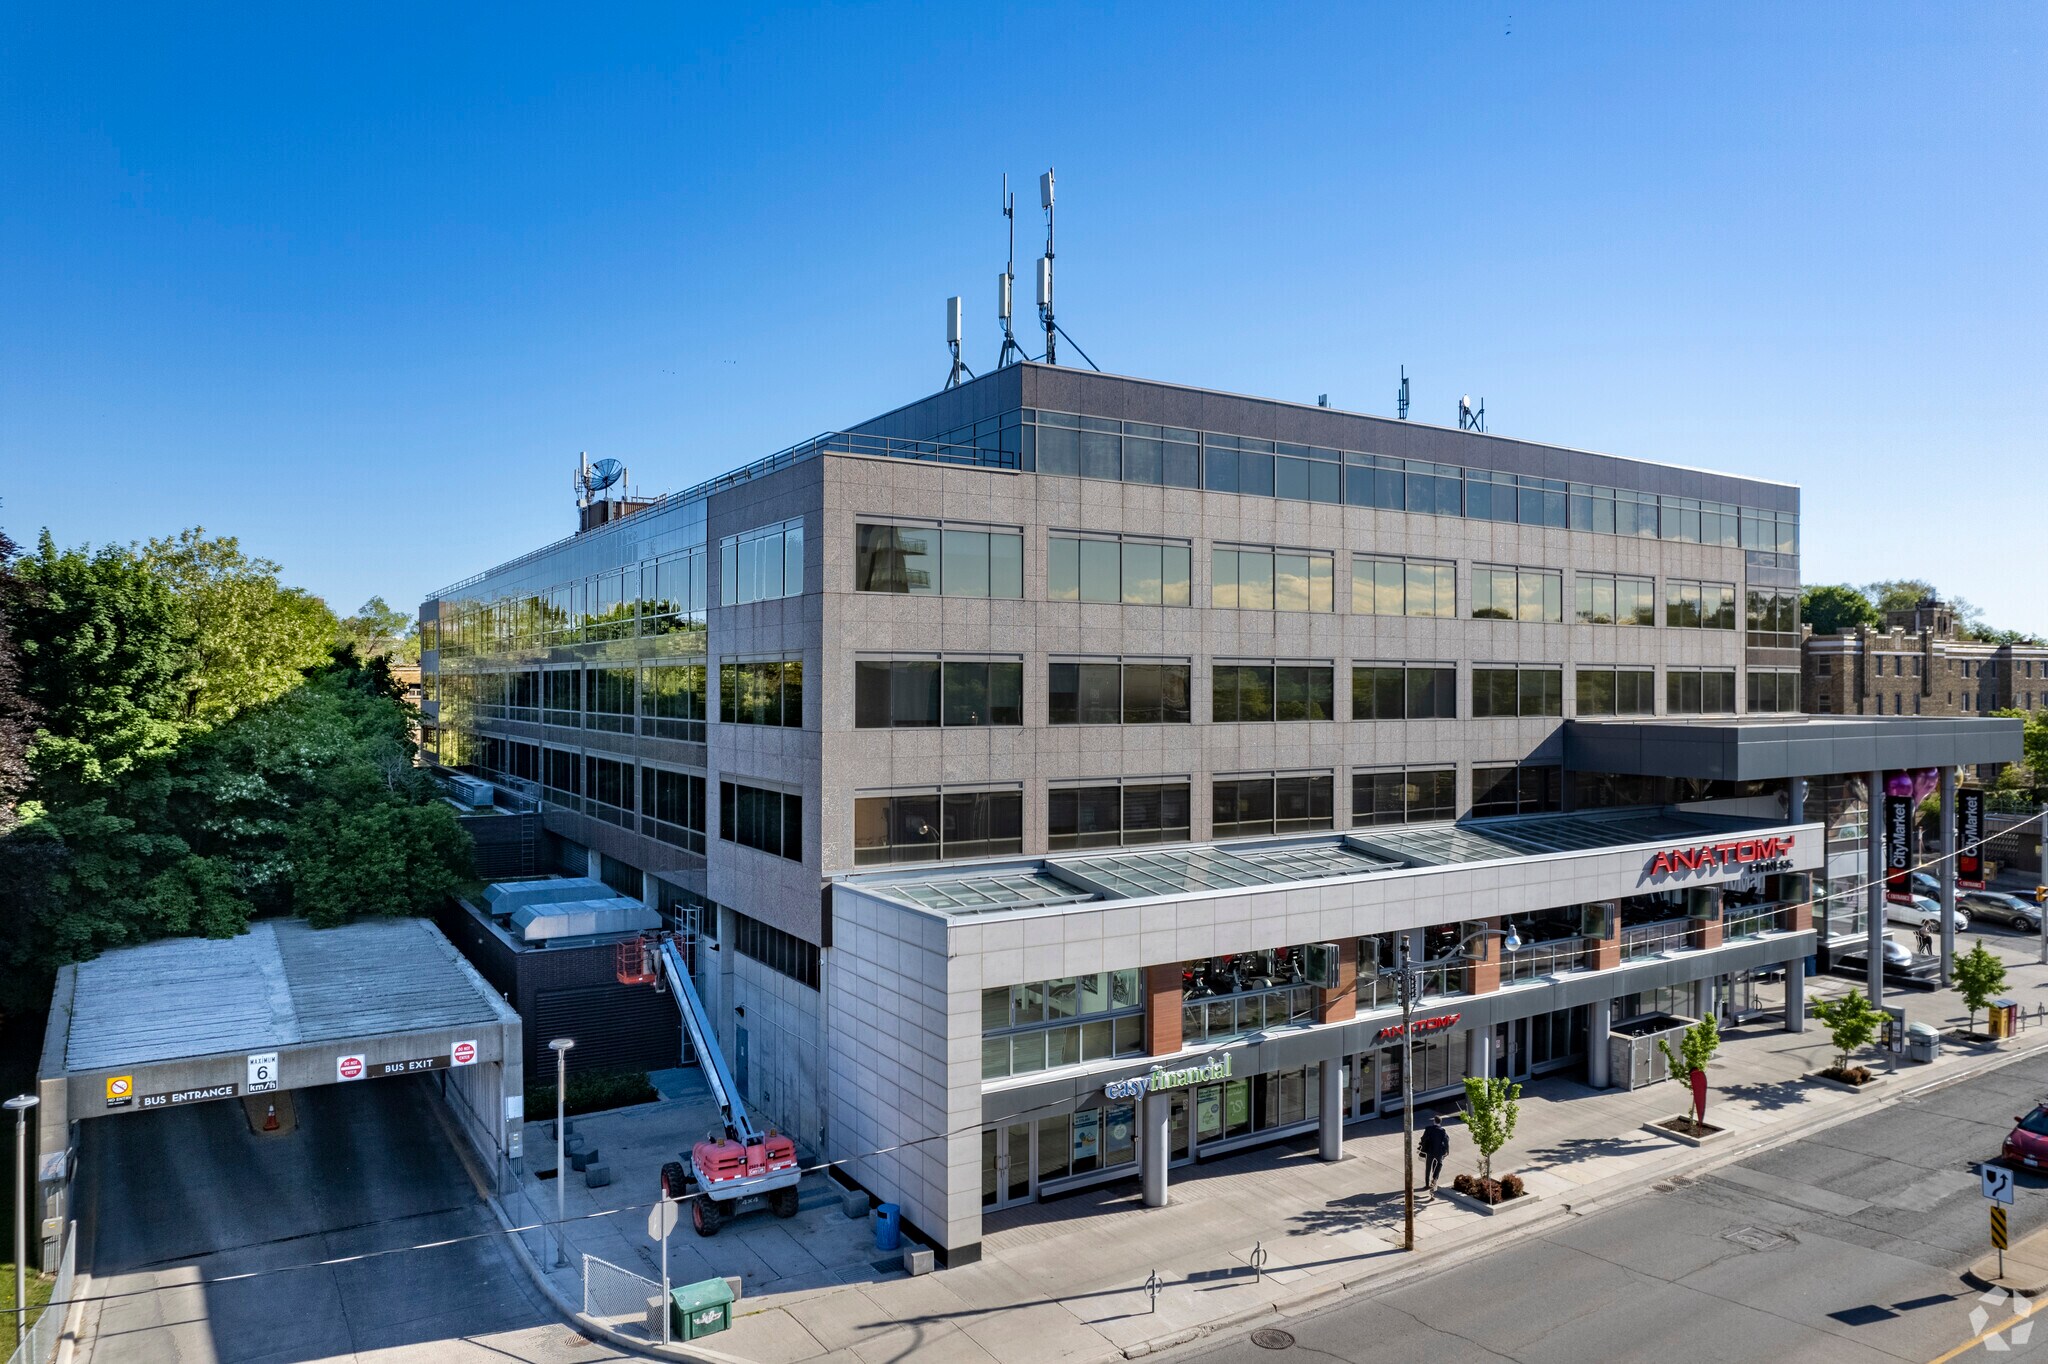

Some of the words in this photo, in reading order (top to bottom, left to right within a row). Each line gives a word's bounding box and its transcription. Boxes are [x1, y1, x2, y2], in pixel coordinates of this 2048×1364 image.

[1893, 803, 1909, 868] CityMarket
[1650, 835, 1795, 876] ANATOMY
[1749, 859, 1794, 874] FITNESS
[1380, 1013, 1461, 1039] ANTOMY
[250, 1056, 276, 1064] MAXIMUM
[385, 1063, 404, 1073] BUS
[409, 1059, 433, 1070] EXIT
[257, 1066, 268, 1080] 6
[250, 1081, 276, 1091] km/h
[144, 1096, 166, 1106] BUS
[171, 1086, 232, 1103] ENTRANCE
